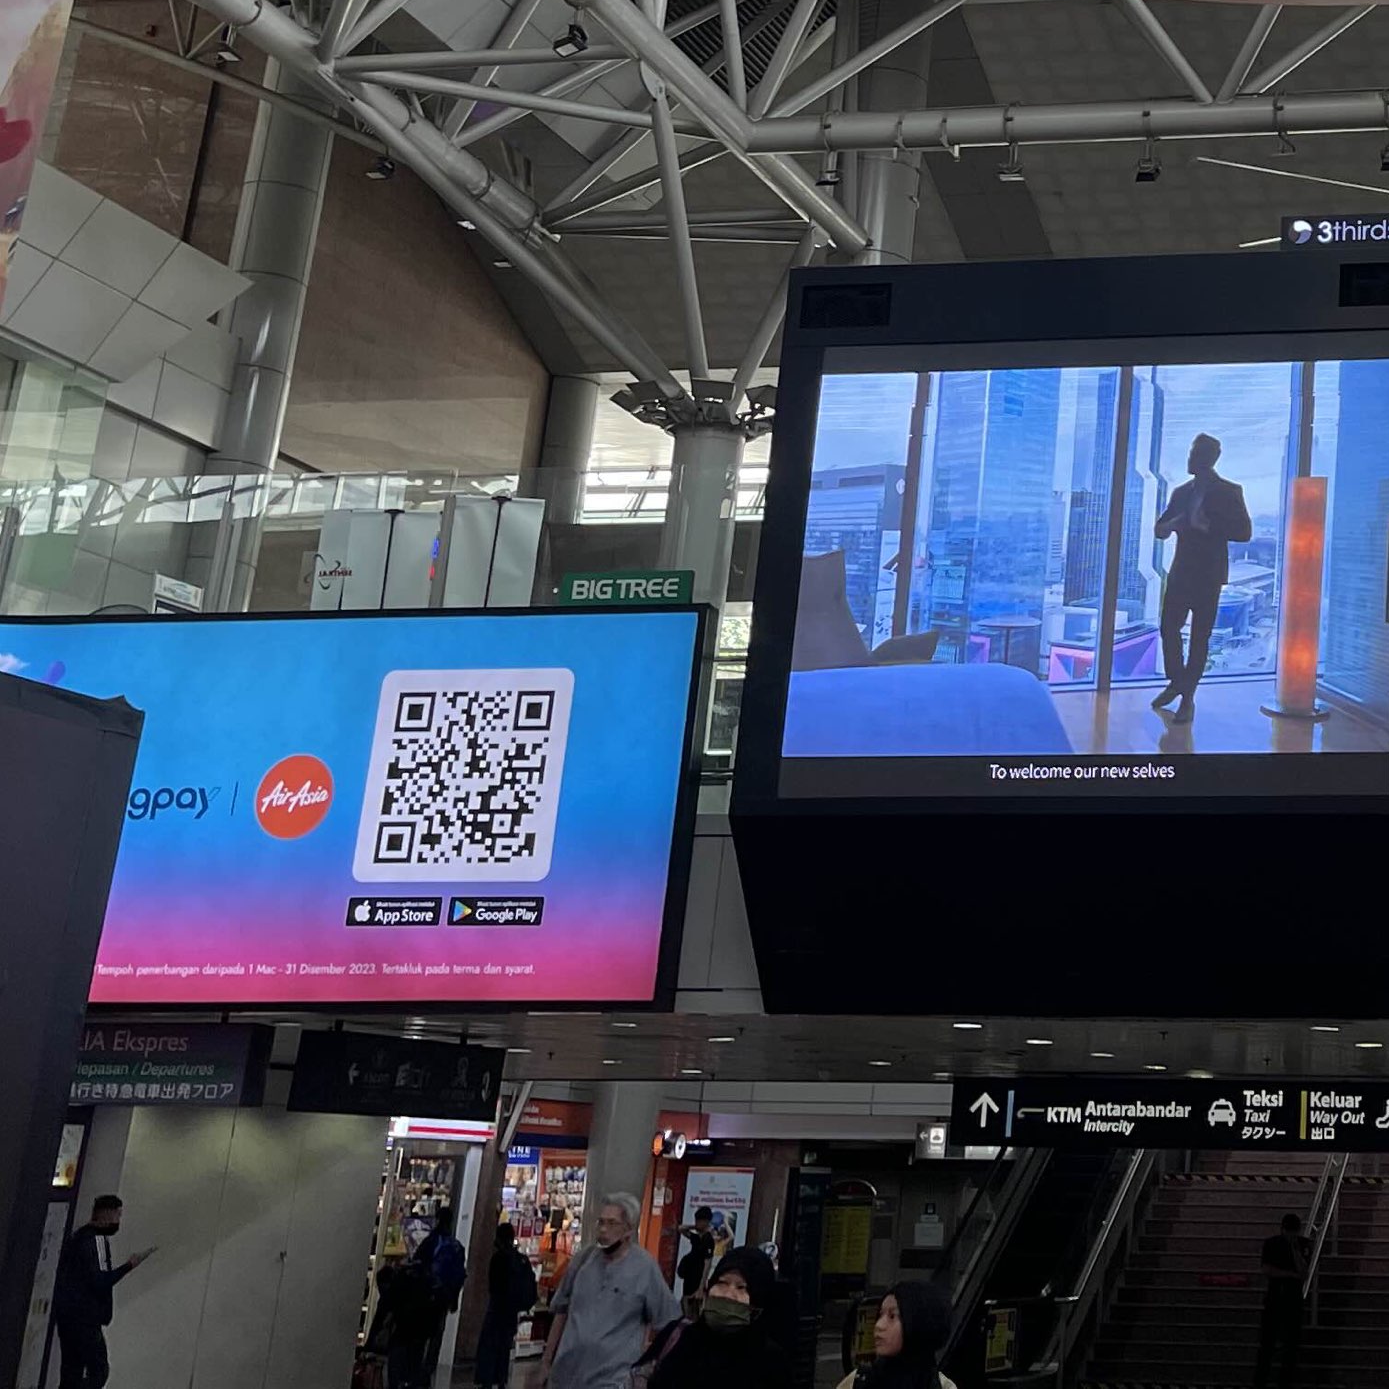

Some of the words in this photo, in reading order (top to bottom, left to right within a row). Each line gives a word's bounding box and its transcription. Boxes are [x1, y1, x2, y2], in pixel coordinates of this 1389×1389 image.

[989, 763, 1007, 779] To
[1009, 763, 1071, 779] welcome
[1073, 766, 1099, 779] our
[1100, 766, 1131, 779] new
[1132, 762, 1176, 779] selves
[127, 786, 222, 820] gpay
[374, 908, 400, 924] App
[401, 907, 434, 923] Store
[475, 908, 514, 923] Google
[515, 908, 538, 923] Play
[202, 963, 245, 977] daripada
[256, 964, 276, 974] Mac
[285, 963, 296, 974] 31
[300, 963, 346, 975] Disember
[425, 963, 450, 976] pada
[453, 963, 480, 975] terma
[483, 963, 501, 975] dan
[112, 1029, 190, 1059] Ekspres
[140, 1061, 215, 1078] Departures
[1242, 1090, 1284, 1108] Teksi
[1310, 1091, 1363, 1108] Keluar
[1046, 1106, 1082, 1124] KTM
[1084, 1099, 1192, 1119] Antarabandar
[1243, 1109, 1271, 1124] Taxi
[1310, 1110, 1339, 1127] Way
[1341, 1110, 1366, 1124] Out
[1083, 1119, 1136, 1137] Intercity
[1241, 1126, 1287, 1140] タクシー
[1310, 1126, 1335, 1140] 出口
